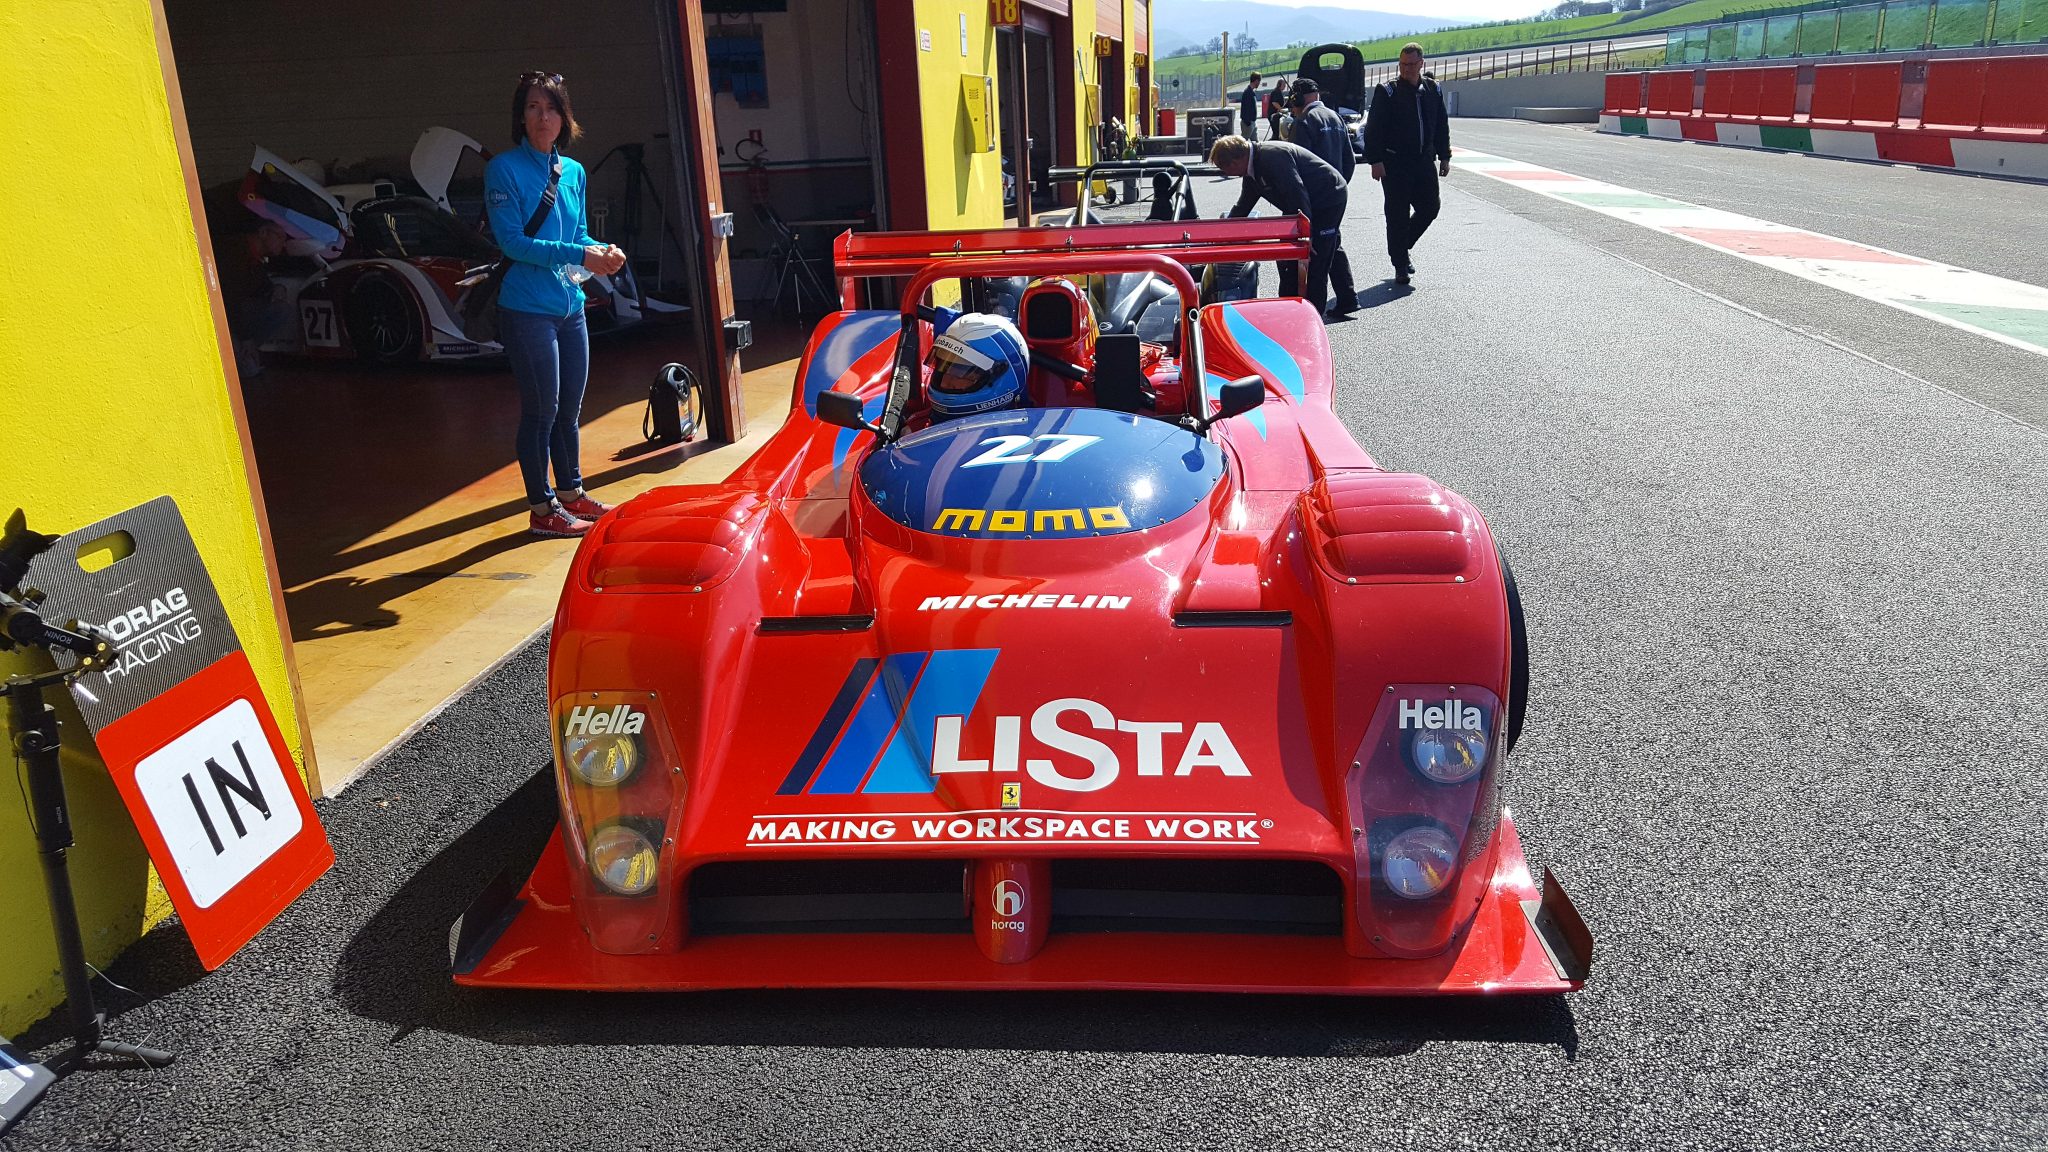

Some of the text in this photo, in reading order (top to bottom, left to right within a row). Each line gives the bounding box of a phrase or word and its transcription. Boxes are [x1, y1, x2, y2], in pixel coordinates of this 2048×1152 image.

[991, 0, 1018, 23] 18
[1096, 38, 1110, 55] 19
[1134, 55, 1145, 66] 20
[304, 307, 332, 340] 27
[975, 393, 1014, 411] LIENHARD
[960, 434, 1104, 468] 27
[100, 586, 189, 642] ORAG
[917, 594, 1133, 611] MICHELIN
[44, 629, 73, 646] RONIN
[564, 704, 646, 737] Hella
[1398, 699, 1482, 730] Hella
[932, 697, 1253, 792] LISTA
[181, 739, 272, 856] IN
[746, 819, 897, 841] MAKING
[911, 817, 1130, 839] WORKSPACE
[991, 919, 1025, 933] horag
